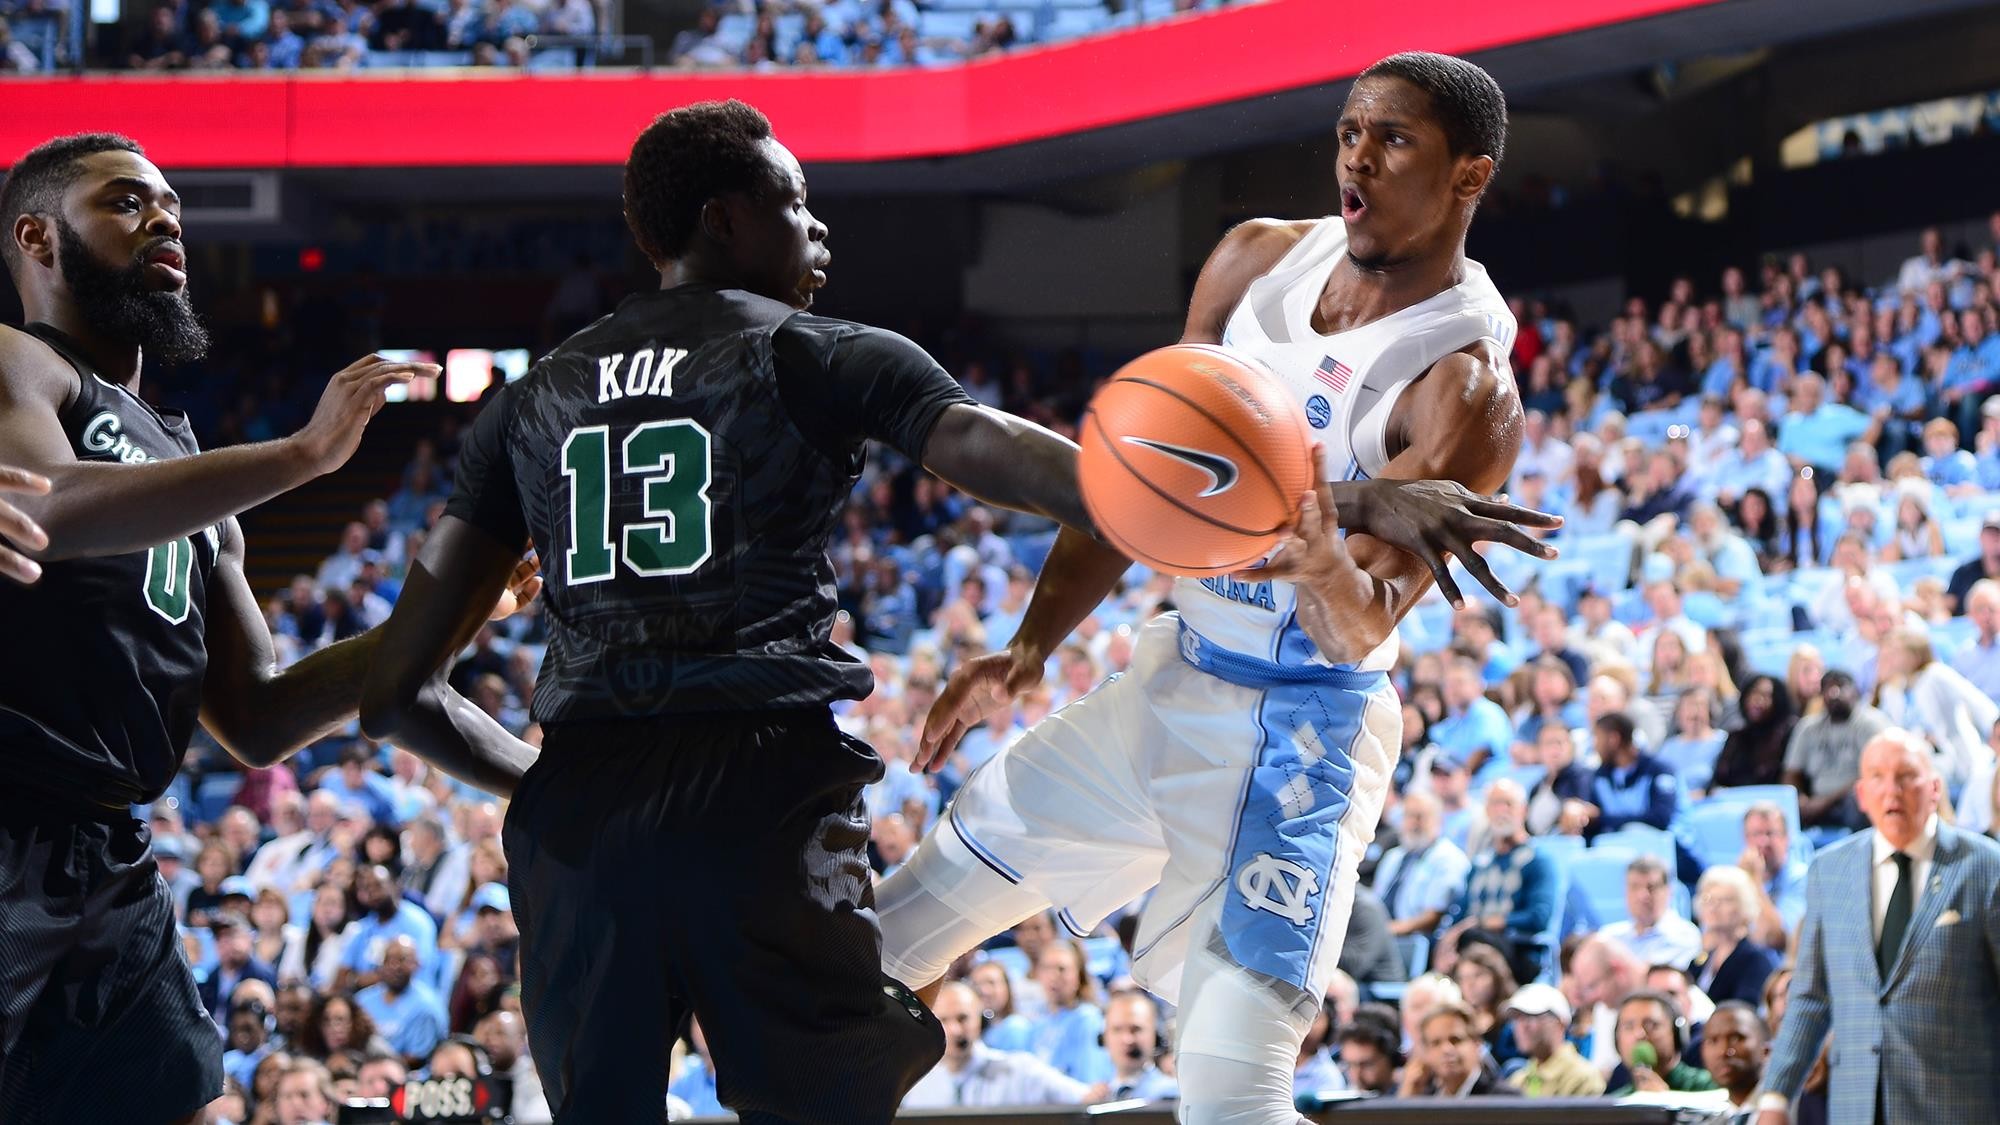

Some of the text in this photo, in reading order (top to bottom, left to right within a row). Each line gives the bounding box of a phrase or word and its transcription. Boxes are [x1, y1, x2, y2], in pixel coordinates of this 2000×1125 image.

[598, 347, 688, 403] KOK
[83, 410, 158, 463] Gre
[561, 417, 712, 586] 13
